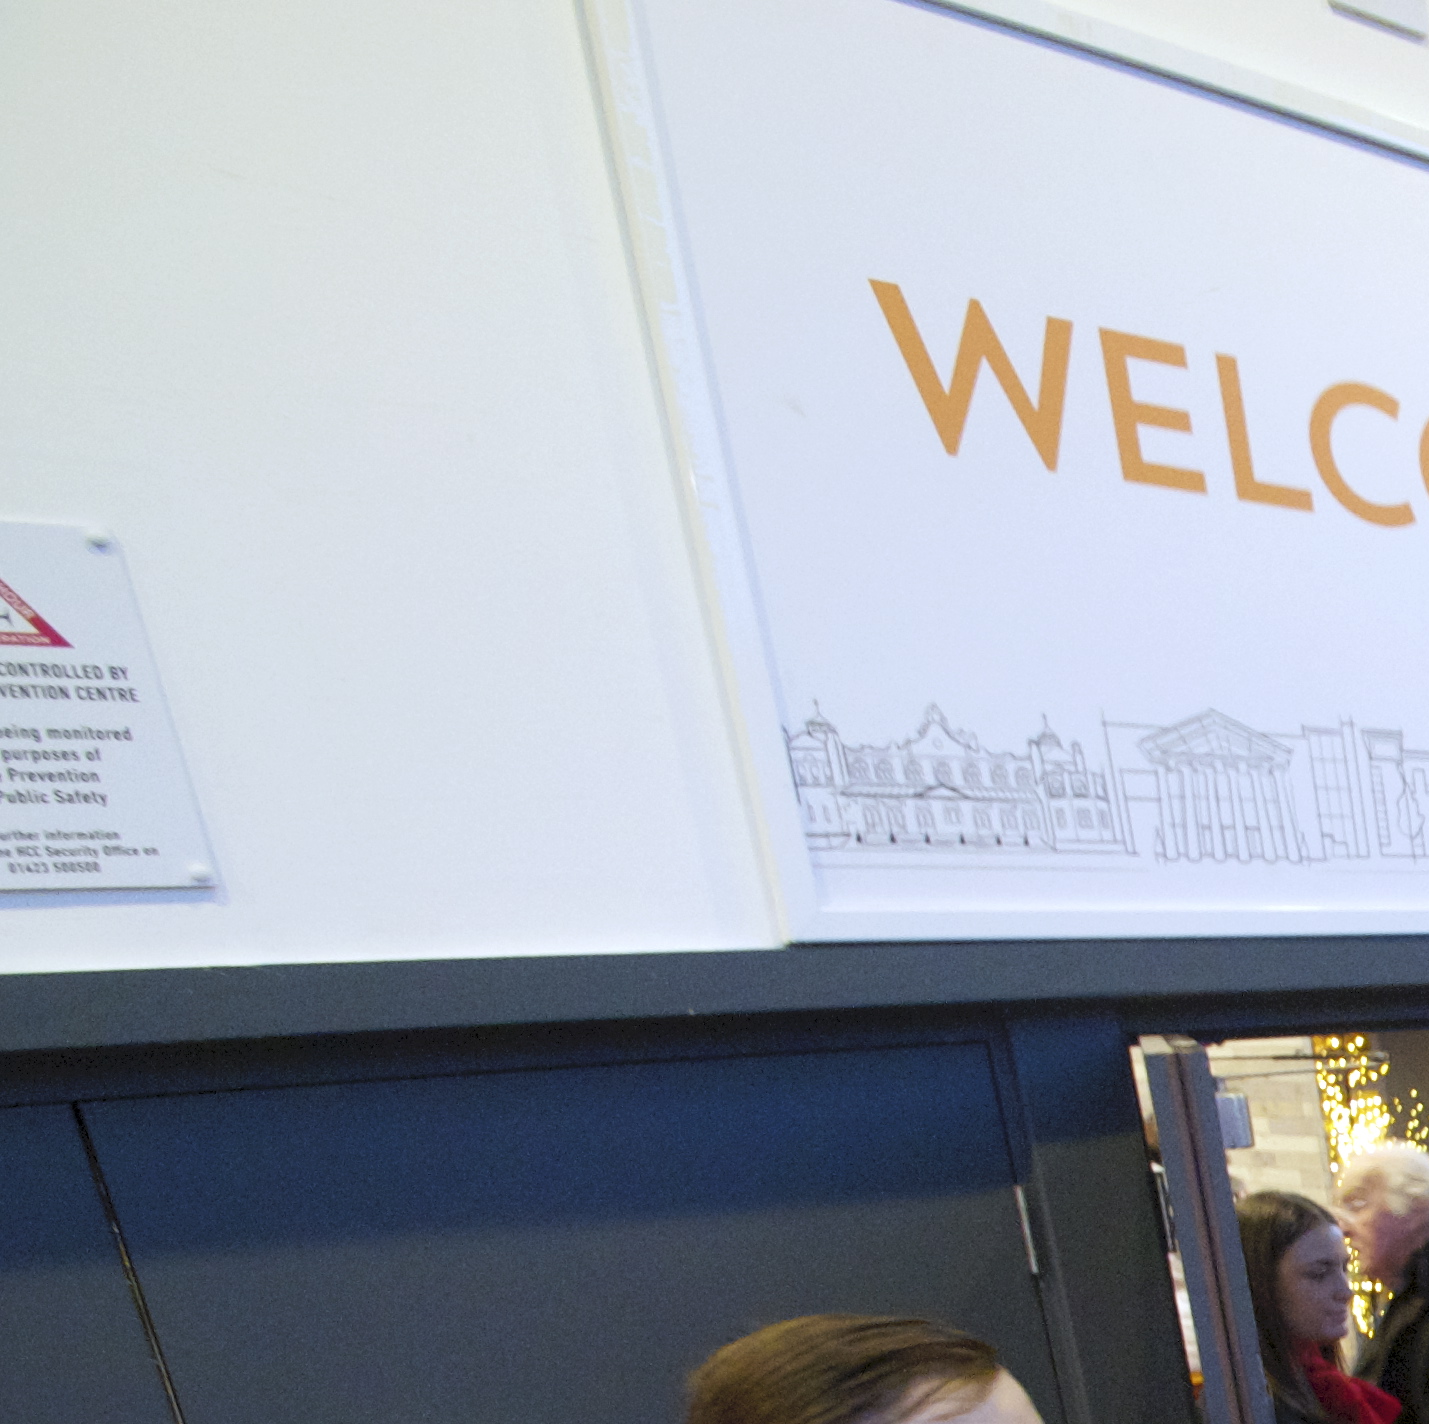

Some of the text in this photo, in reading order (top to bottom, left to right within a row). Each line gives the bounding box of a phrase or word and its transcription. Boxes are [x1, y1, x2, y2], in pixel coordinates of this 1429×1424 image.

[107, 665, 129, 681] BY
[74, 685, 140, 703] CENTRE
[0, 724, 133, 743] eing monitored
[1, 747, 101, 763] purposes of
[6, 767, 101, 782] Prevention
[53, 789, 108, 807] Safety
